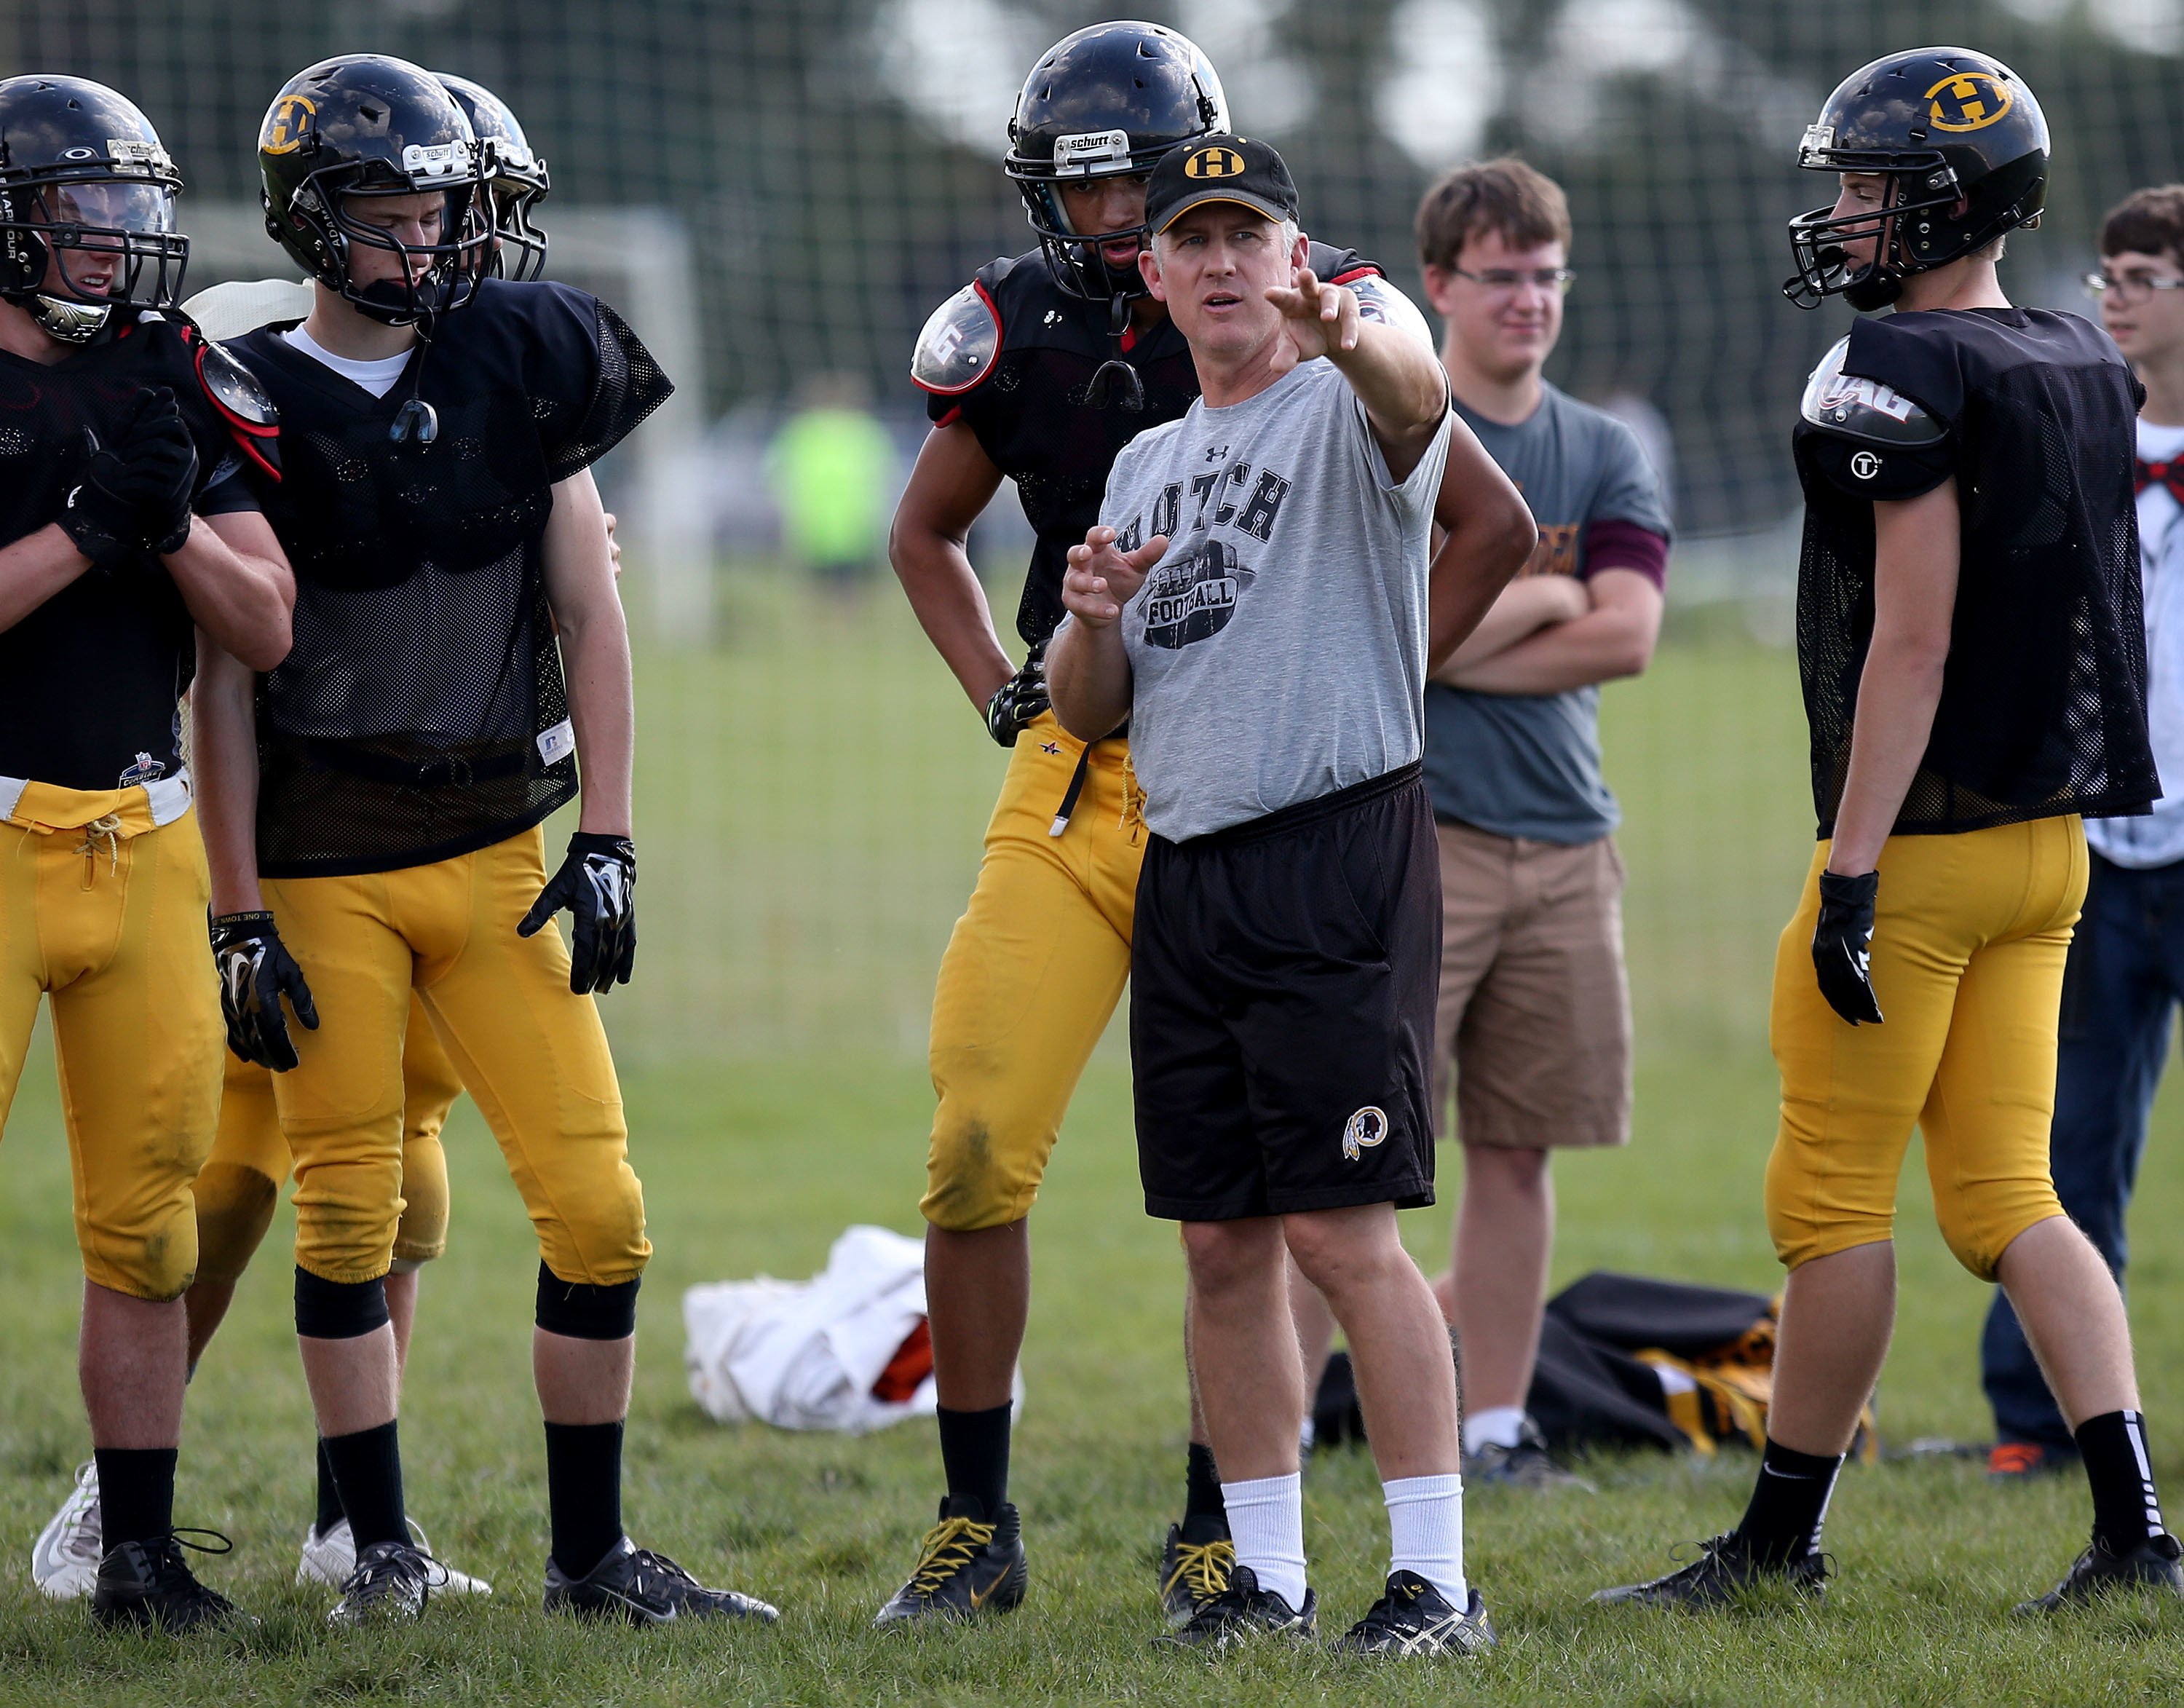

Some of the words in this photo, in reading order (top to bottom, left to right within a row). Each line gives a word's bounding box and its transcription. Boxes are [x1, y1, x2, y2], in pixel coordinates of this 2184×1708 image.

[1070, 135, 1109, 149] schutt
[426, 149, 449, 158] schutt
[1192, 149, 1238, 177] H
[2, 198, 16, 259] AROUR
[1148, 582, 1233, 625] FOOTBALL
[221, 915, 242, 924] TOWN
[244, 913, 260, 921] ONE
